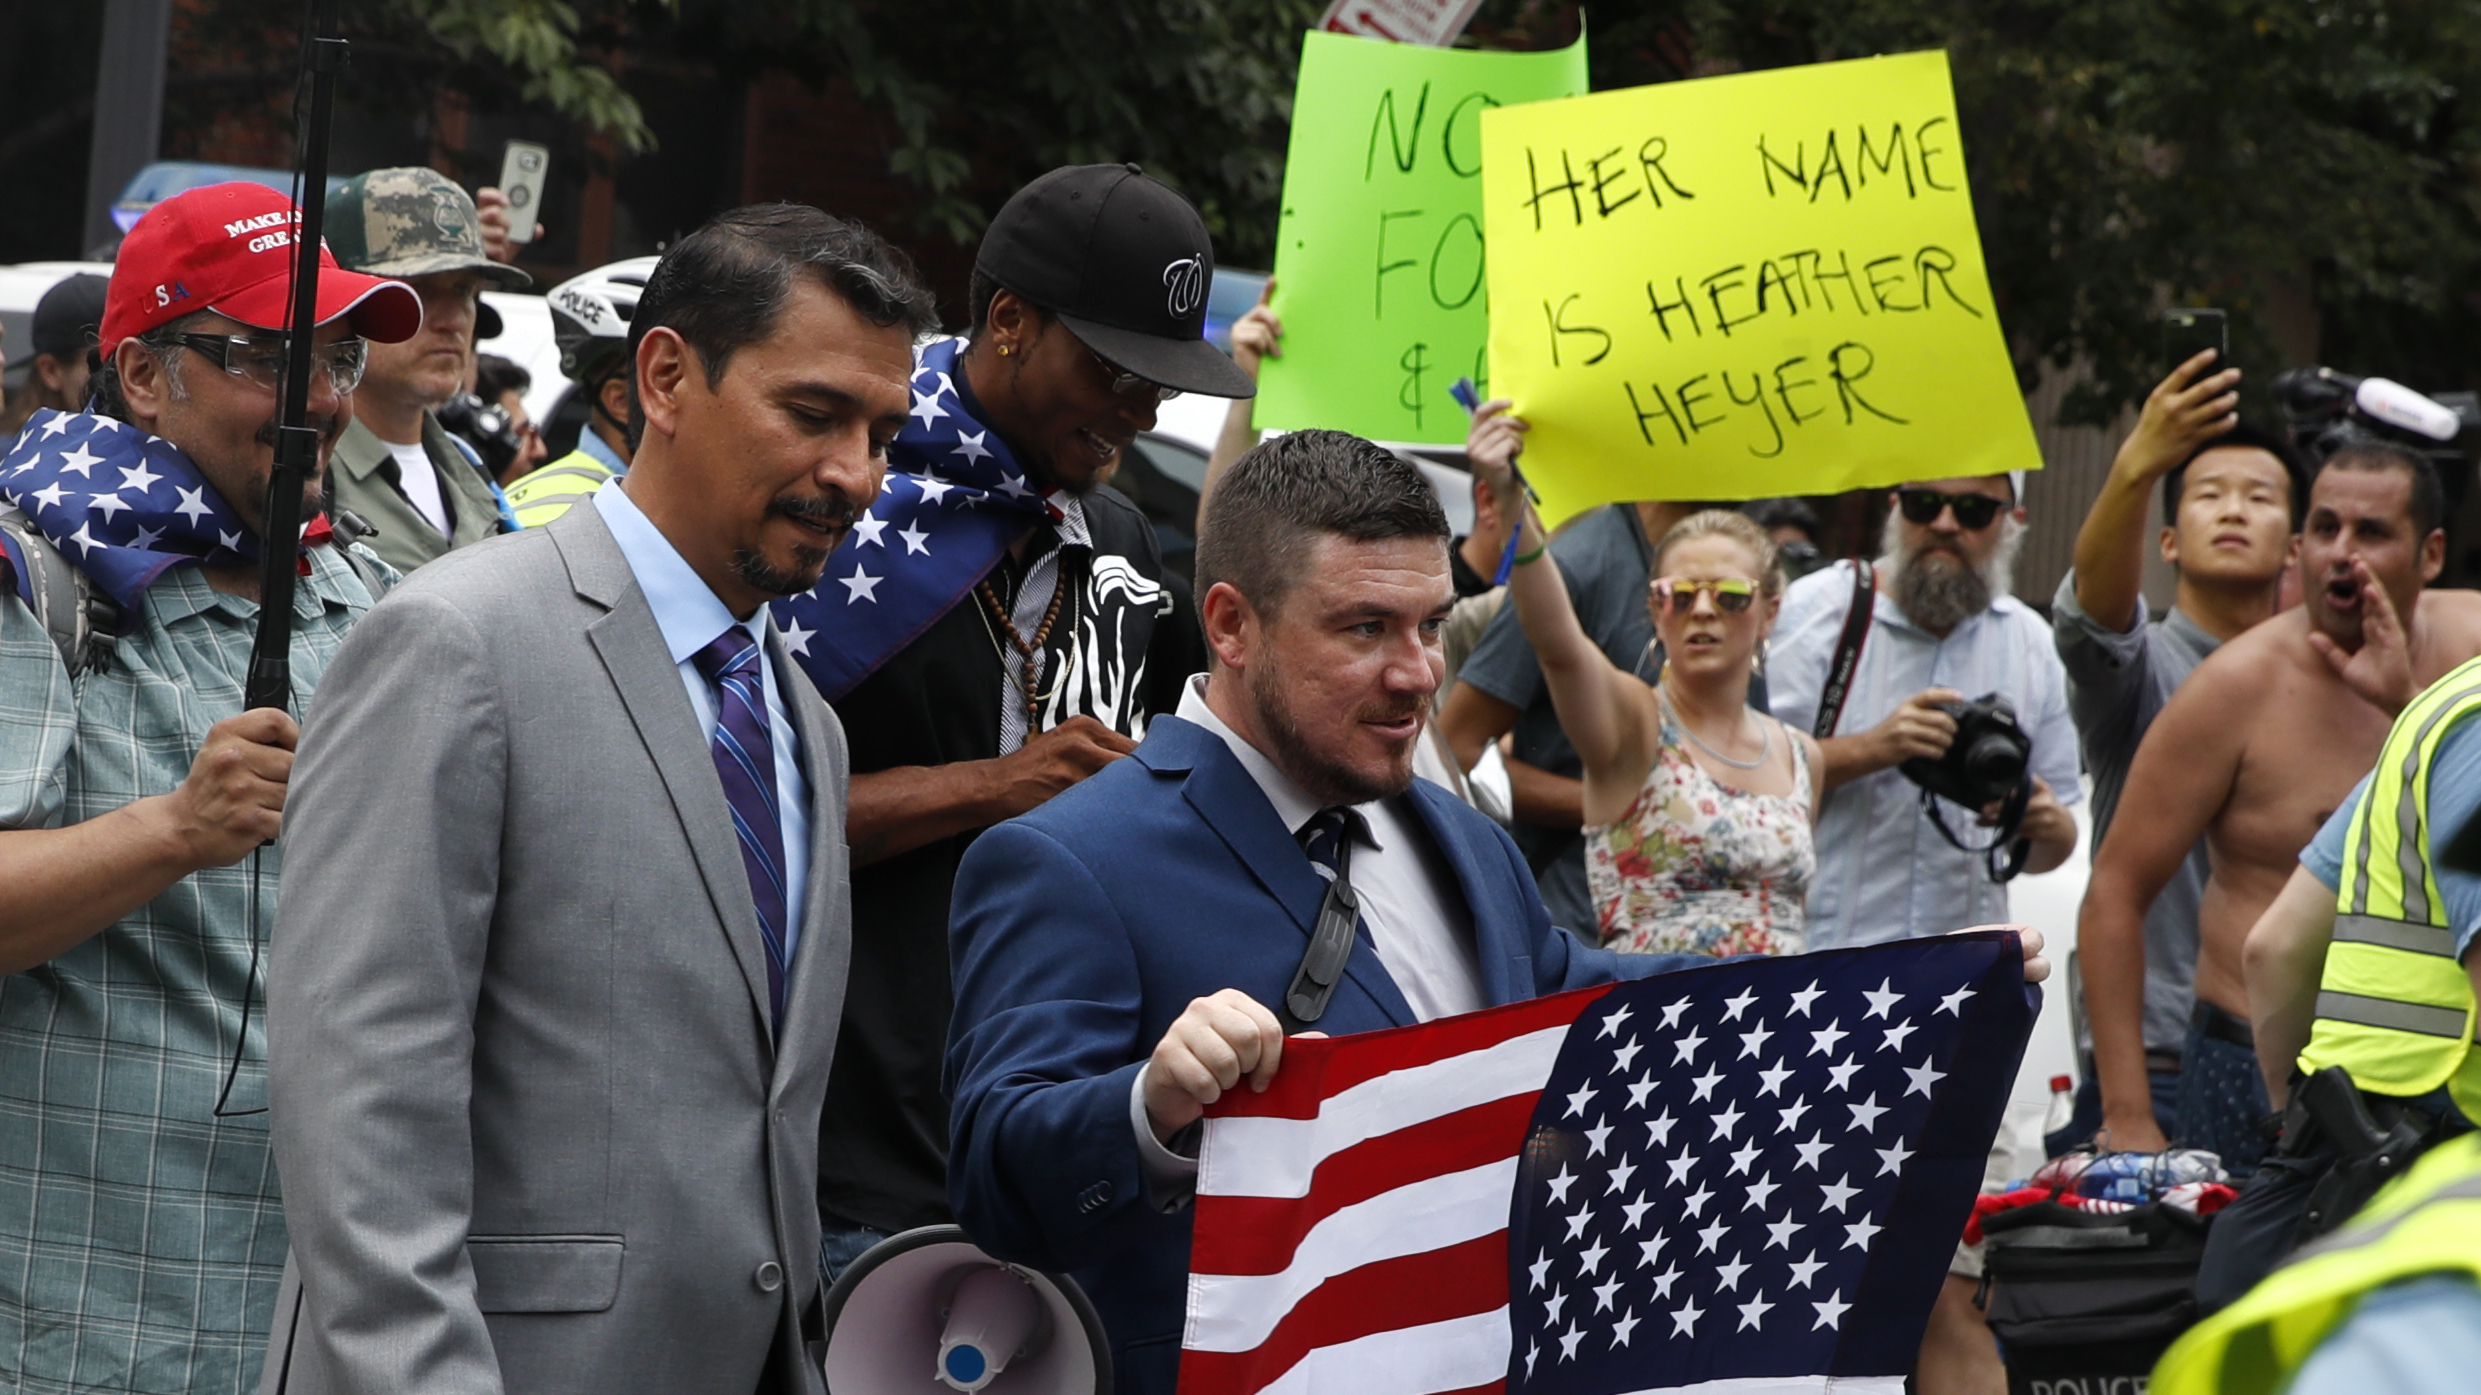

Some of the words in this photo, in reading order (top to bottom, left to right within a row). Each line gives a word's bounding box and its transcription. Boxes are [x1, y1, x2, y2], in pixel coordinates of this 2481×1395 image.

[224, 212, 286, 238] MAKE
[1522, 136, 1695, 232] HER
[1755, 116, 1956, 203] NAME
[248, 228, 302, 254] GRE
[1374, 208, 1489, 320] FO
[559, 288, 606, 325] POLICE
[1543, 293, 1612, 368] IS
[1646, 245, 1984, 342] HEATHER
[1623, 341, 1911, 458] HEYER
